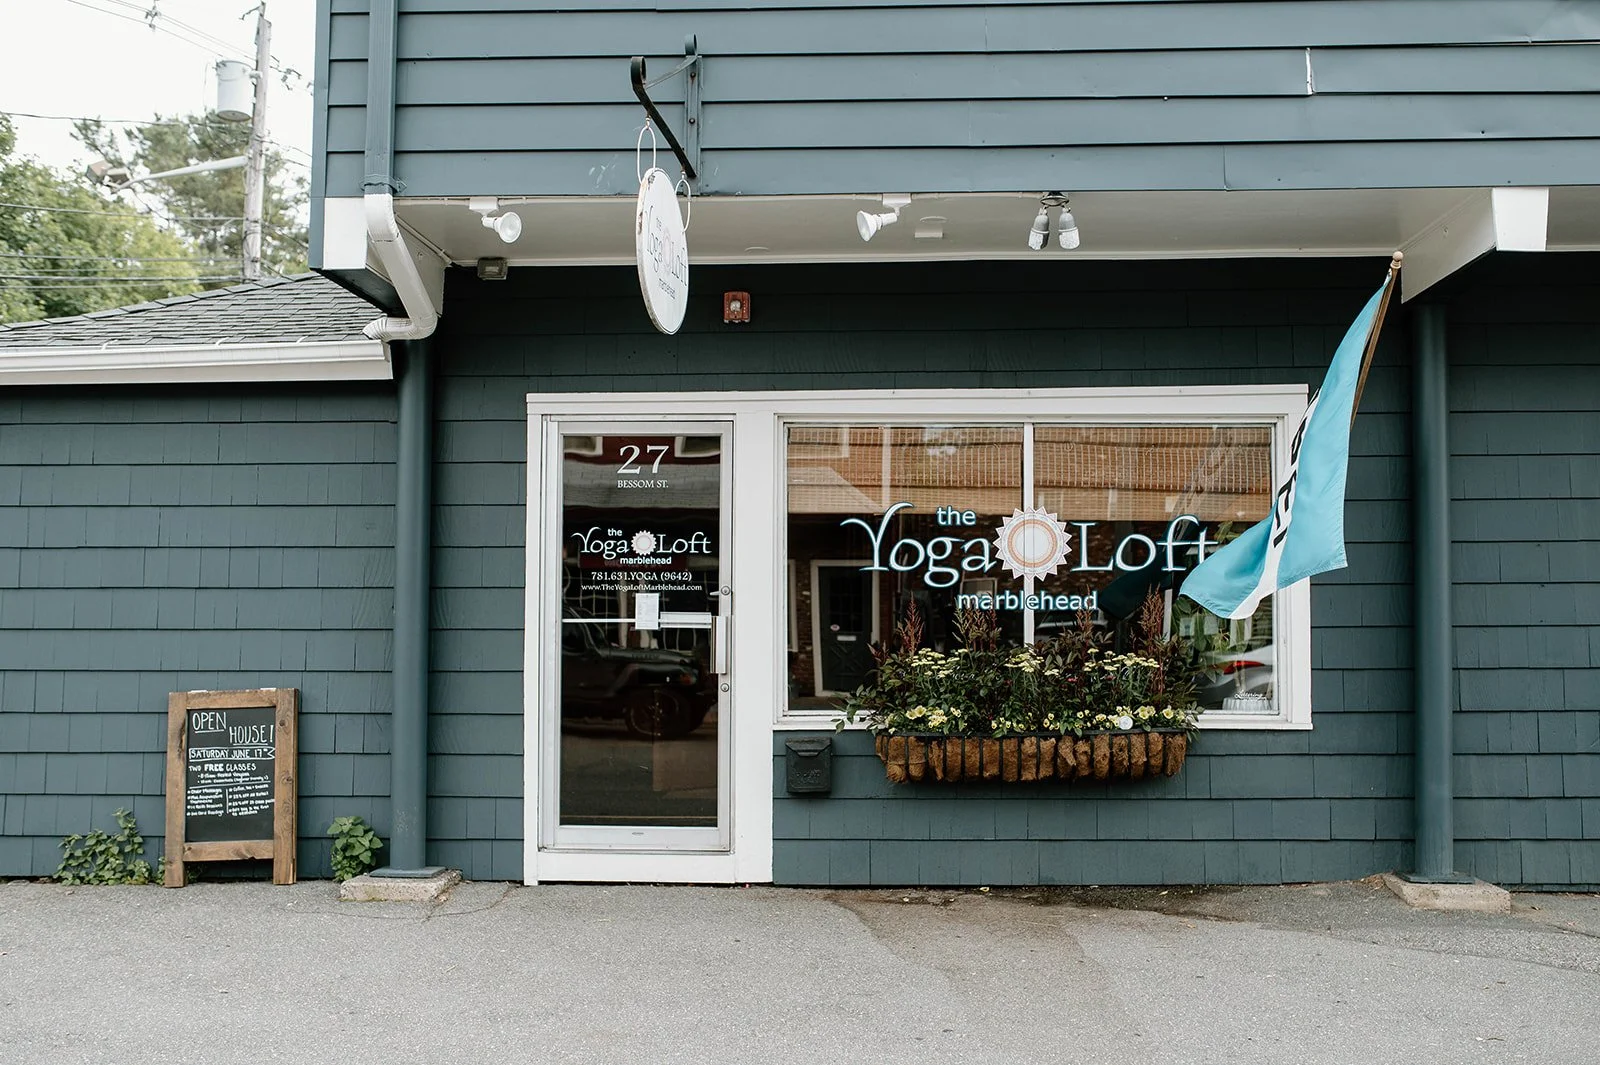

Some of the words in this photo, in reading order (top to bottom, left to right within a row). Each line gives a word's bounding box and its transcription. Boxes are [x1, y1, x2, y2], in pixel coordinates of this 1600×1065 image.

[616, 444, 670, 475] 27
[617, 479, 654, 488] BESSOM
[656, 479, 669, 488] ST.
[937, 505, 977, 527] the
[607, 528, 623, 537] the
[570, 526, 630, 560] Yoga
[654, 531, 712, 554] Loft
[839, 501, 998, 589] Yoga
[1068, 513, 1220, 574] Loft
[619, 556, 672, 565] marblehead
[591, 571, 658, 581] 781.631.YOGA
[660, 571, 693, 582] (9642)
[581, 583, 703, 592] www.TheYogaLoftMarblehead.com
[957, 590, 1099, 611] marblehead
[192, 711, 227, 730] OPEN
[190, 749, 229, 758] SATURDAY
[232, 749, 251, 758] JUNE
[254, 748, 268, 757] 17
[204, 763, 224, 772] FREE
[226, 763, 257, 771] CLASSES
